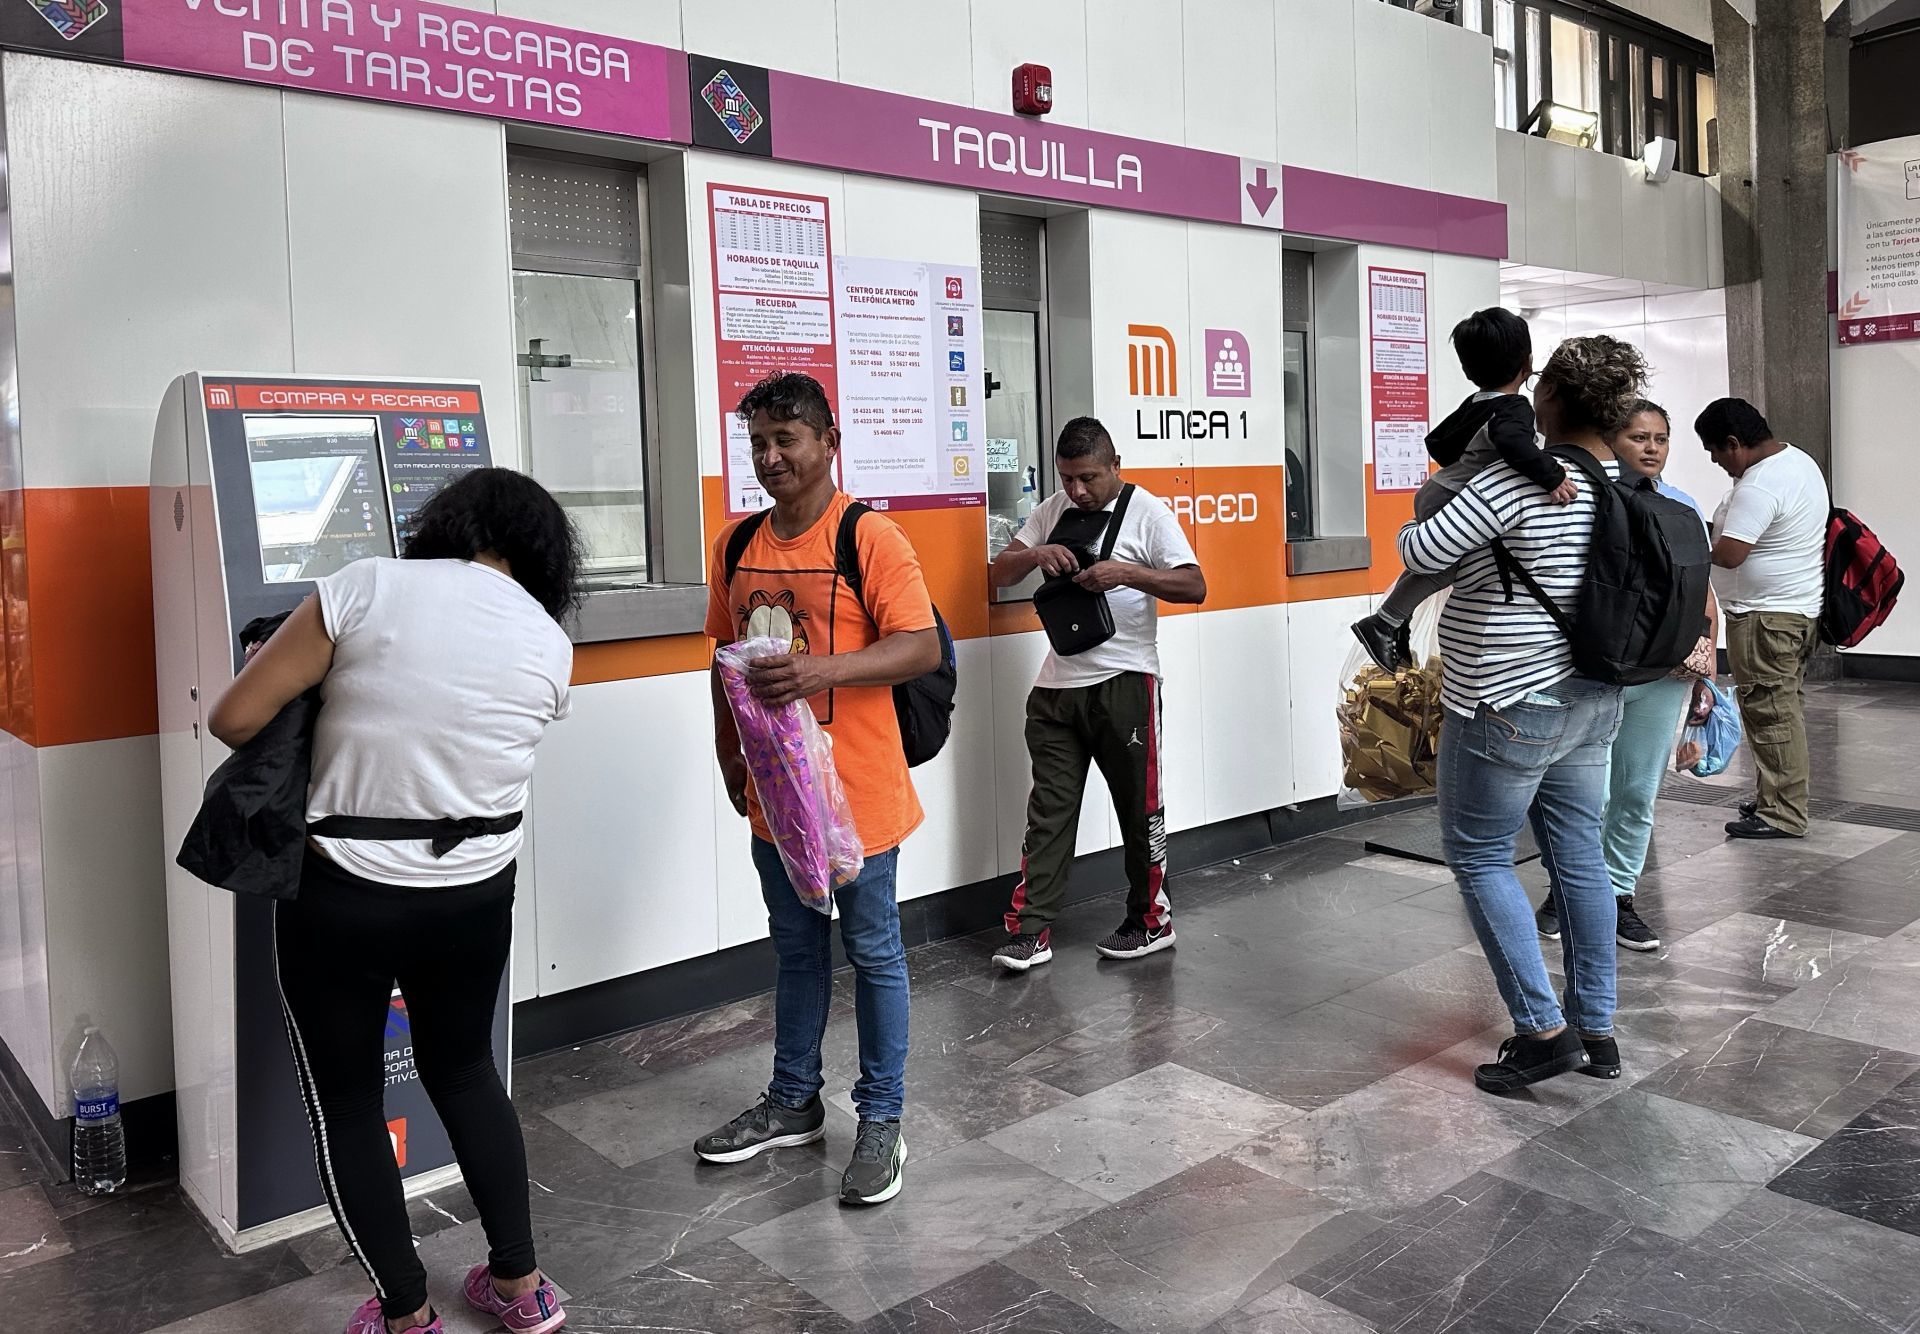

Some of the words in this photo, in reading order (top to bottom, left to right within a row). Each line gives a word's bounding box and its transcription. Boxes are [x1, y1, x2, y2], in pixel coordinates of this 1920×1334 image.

[185, 0, 354, 35] NTA
[371, 3, 401, 42] Y
[418, 13, 630, 82] RECARGA
[243, 31, 315, 76] DE
[333, 45, 582, 116] TARJETAS
[918, 118, 1143, 193] TAQUILLA
[729, 196, 758, 208] TABLA
[760, 200, 771, 210] DE
[773, 202, 811, 214] PRECIOS
[1866, 217, 1914, 230] Únicamente
[1873, 231, 1884, 239] las
[1892, 237, 1920, 246] Tarjeta
[727, 254, 769, 265] HORARIOS
[771, 258, 781, 266] DE
[783, 259, 819, 270] TAQUILLA
[1871, 254, 1886, 262] Más
[1887, 252, 1914, 262] puntos
[1871, 263, 1896, 271] Menos
[1378, 274, 1392, 282] TABLA
[1882, 270, 1916, 280] taquillas
[1871, 281, 1896, 290] Mismo
[1897, 279, 1919, 287] costo
[846, 285, 874, 295] CENTRO
[875, 287, 884, 295] DE
[885, 288, 918, 297] ATENCIÓN
[755, 298, 797, 308] RECUERDA
[850, 295, 891, 305] TELEFÓNICA
[892, 298, 915, 306] METRO
[742, 344, 775, 353] ATENCIÓN
[260, 391, 347, 406] COMPRA
[352, 393, 365, 406] Y
[371, 394, 461, 408] RECARGA
[1136, 409, 1229, 440] LINEA
[1239, 410, 1248, 440] 1
[80, 1102, 107, 1114] BURST
